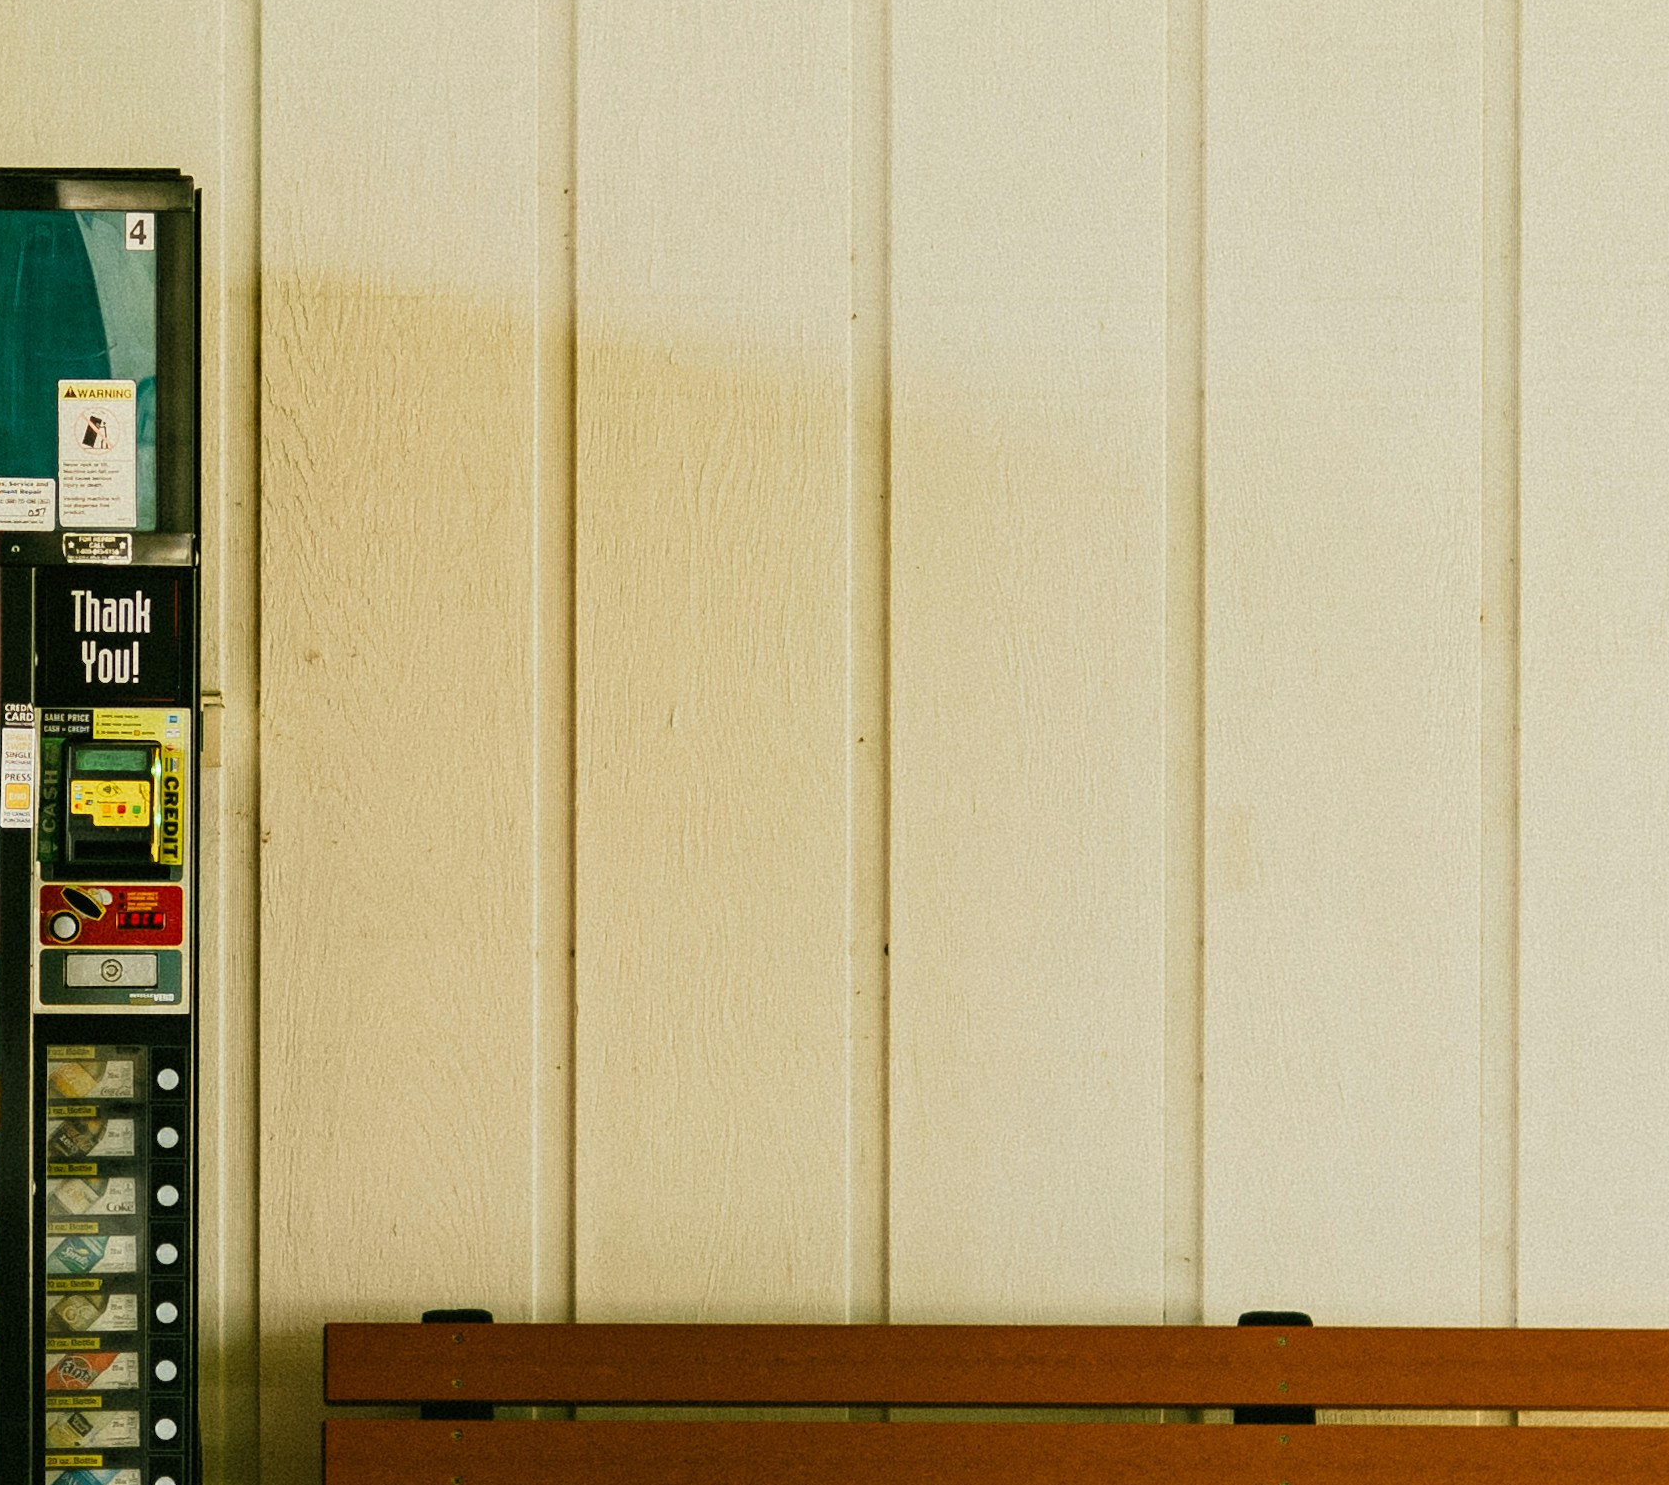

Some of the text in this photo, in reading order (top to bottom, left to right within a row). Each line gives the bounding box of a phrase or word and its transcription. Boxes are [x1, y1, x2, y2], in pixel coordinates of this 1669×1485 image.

[129, 219, 147, 245] 4
[78, 389, 132, 399] WARNING
[71, 589, 151, 634] Thank
[81, 640, 140, 684] You!
[5, 712, 34, 722] CARD
[44, 713, 65, 722] SAME
[67, 713, 90, 723] PRICE
[4, 773, 32, 782] PRESS
[42, 769, 58, 833] CASH
[162, 776, 180, 858] CREDIT
[107, 1201, 134, 1213] Coke
[62, 1246, 89, 1266] Sprite
